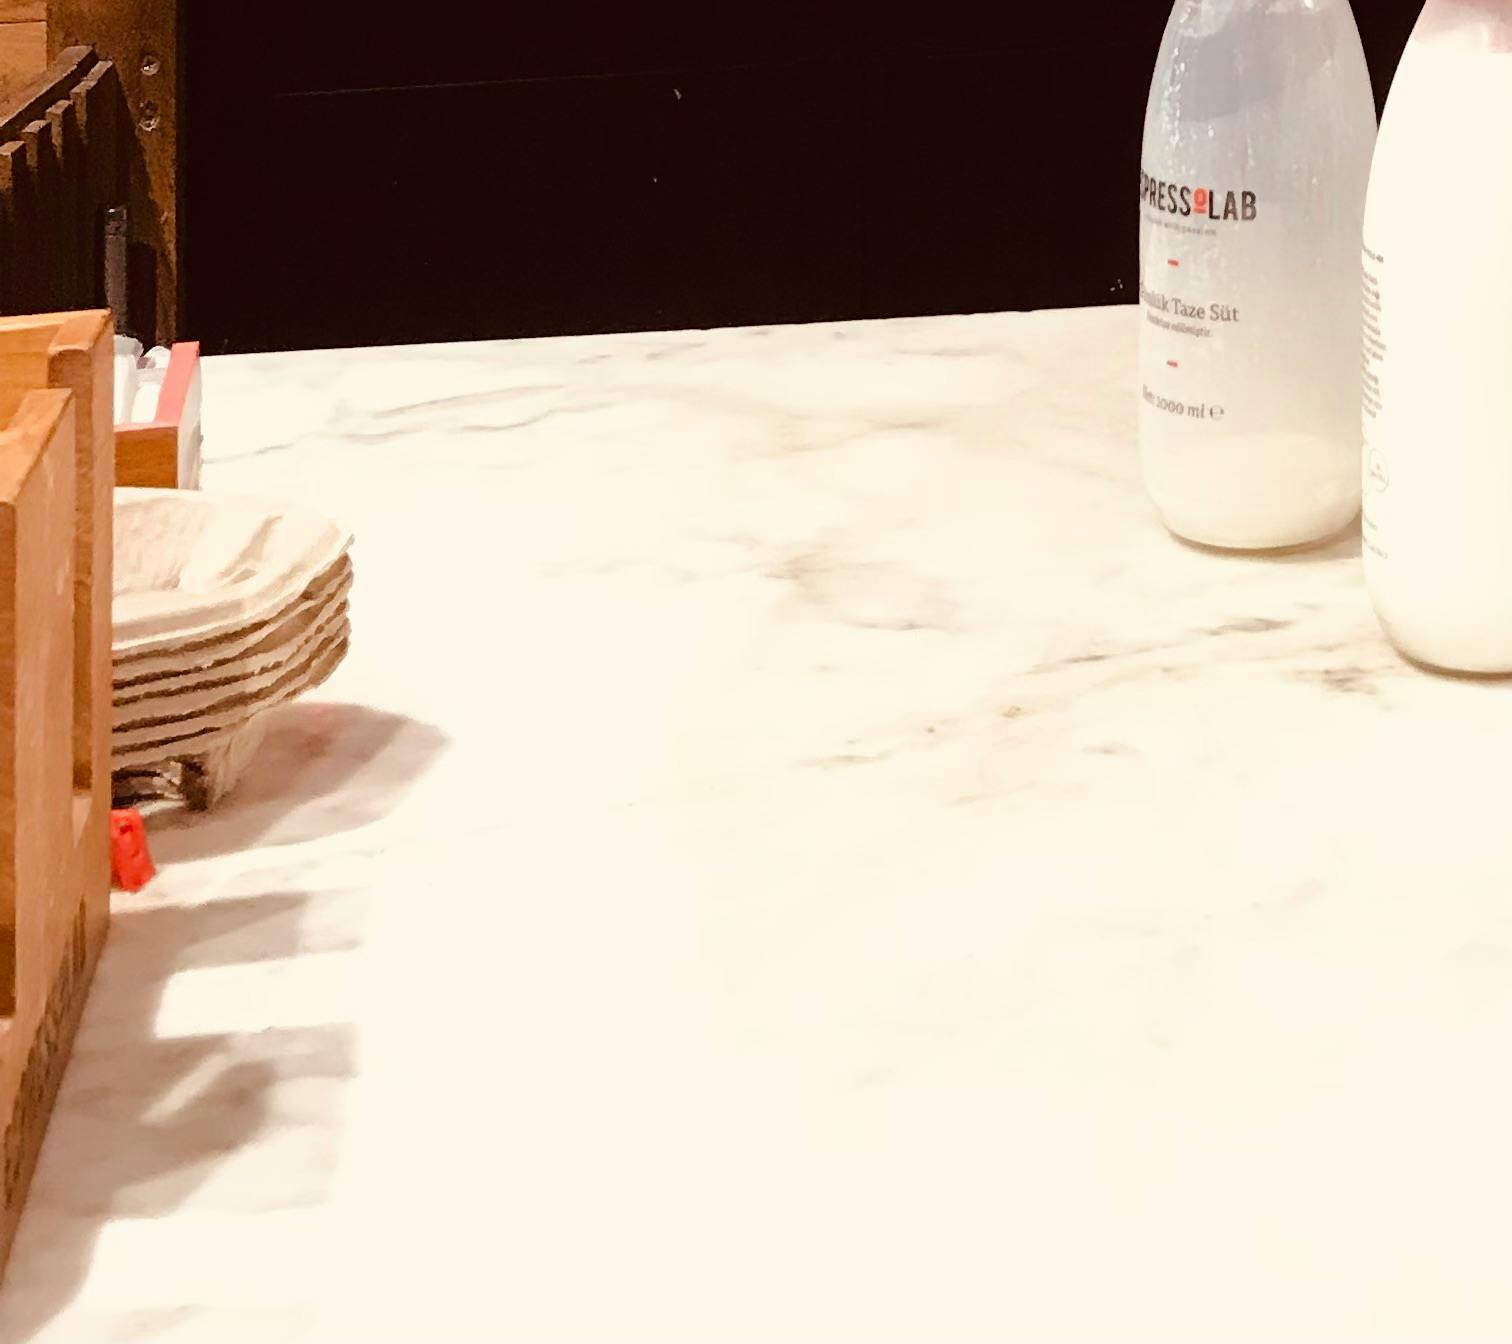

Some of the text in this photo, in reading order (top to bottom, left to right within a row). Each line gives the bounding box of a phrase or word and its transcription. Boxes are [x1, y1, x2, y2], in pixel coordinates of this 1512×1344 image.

[1170, 297, 1206, 320] Taze
[1209, 302, 1240, 323] Süt
[1187, 403, 1206, 419] ml
